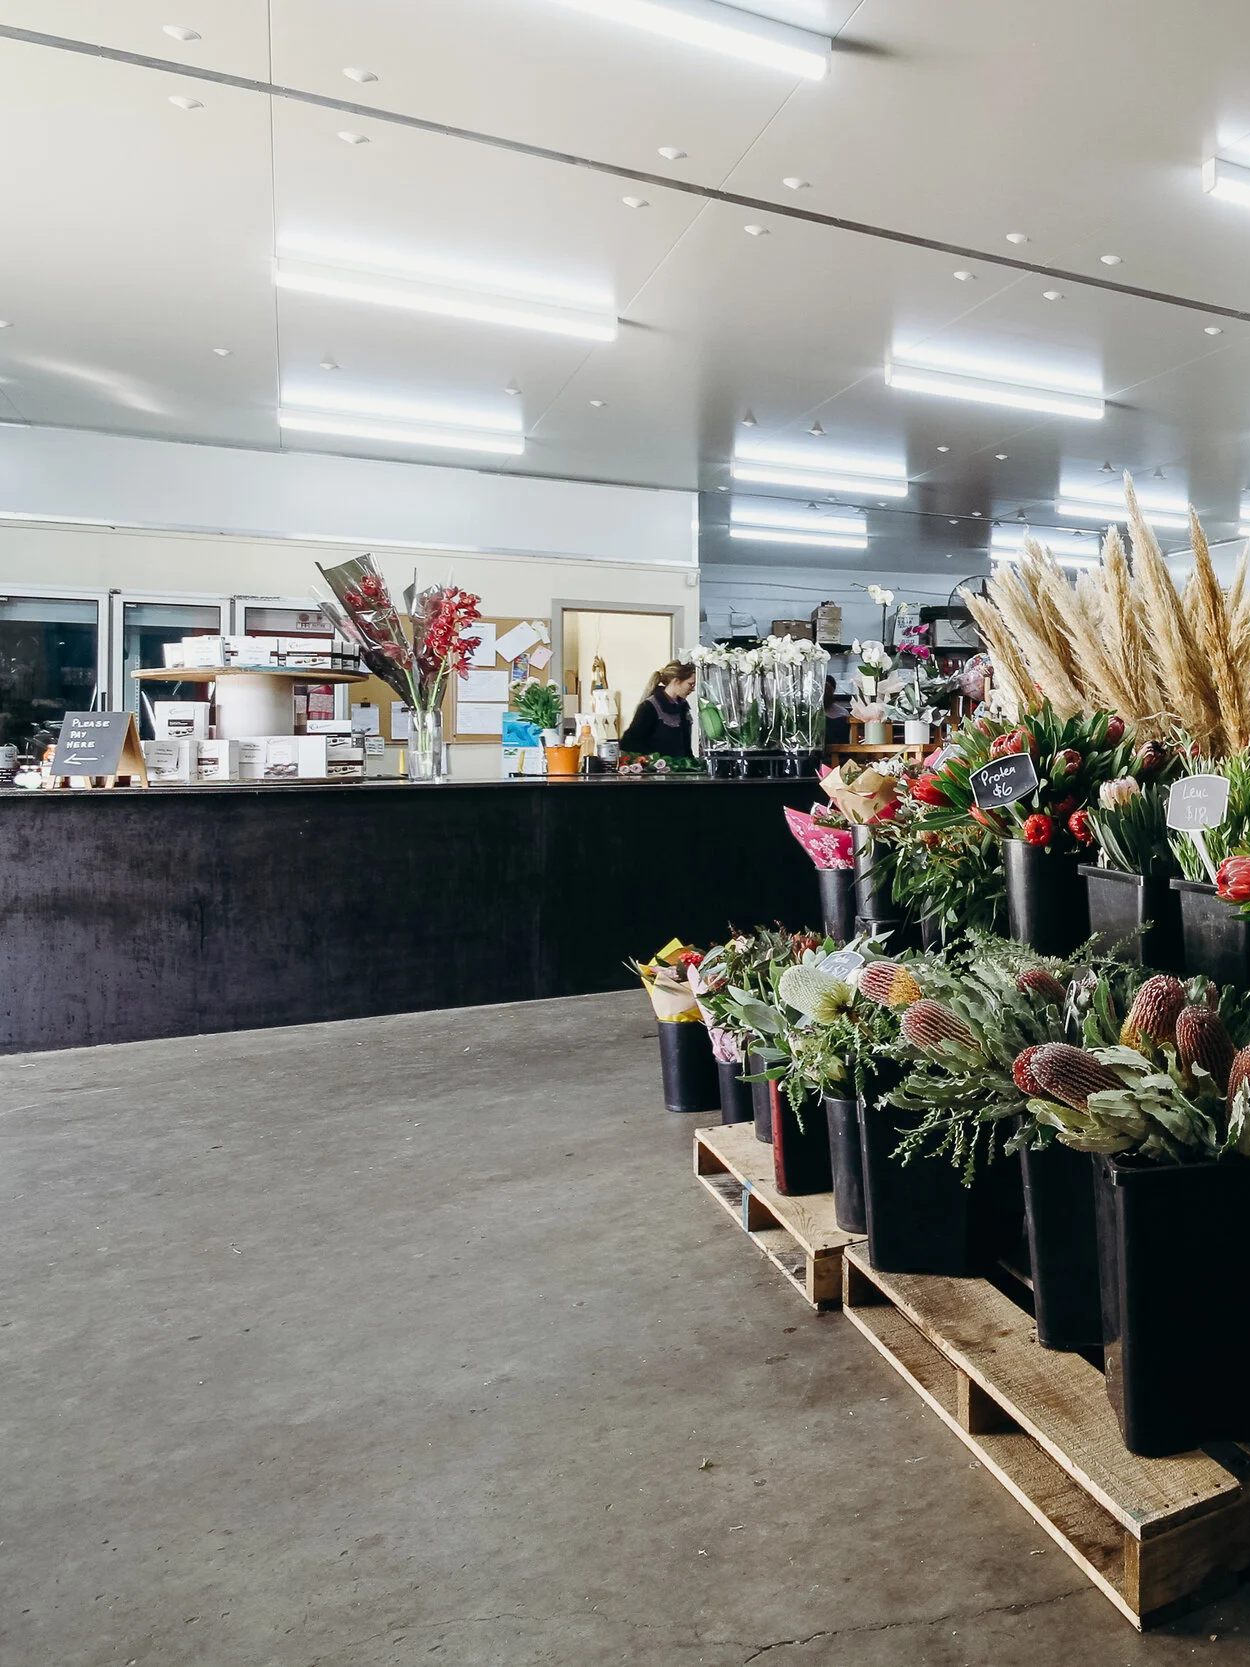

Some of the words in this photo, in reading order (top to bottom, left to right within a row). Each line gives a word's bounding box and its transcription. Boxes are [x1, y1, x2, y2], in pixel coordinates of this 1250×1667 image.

[72, 718, 111, 728] PLEASE
[70, 730, 87, 739] PAY
[66, 741, 96, 749] HERE
[980, 766, 1016, 787] Protea
[992, 782, 1013, 798] $6
